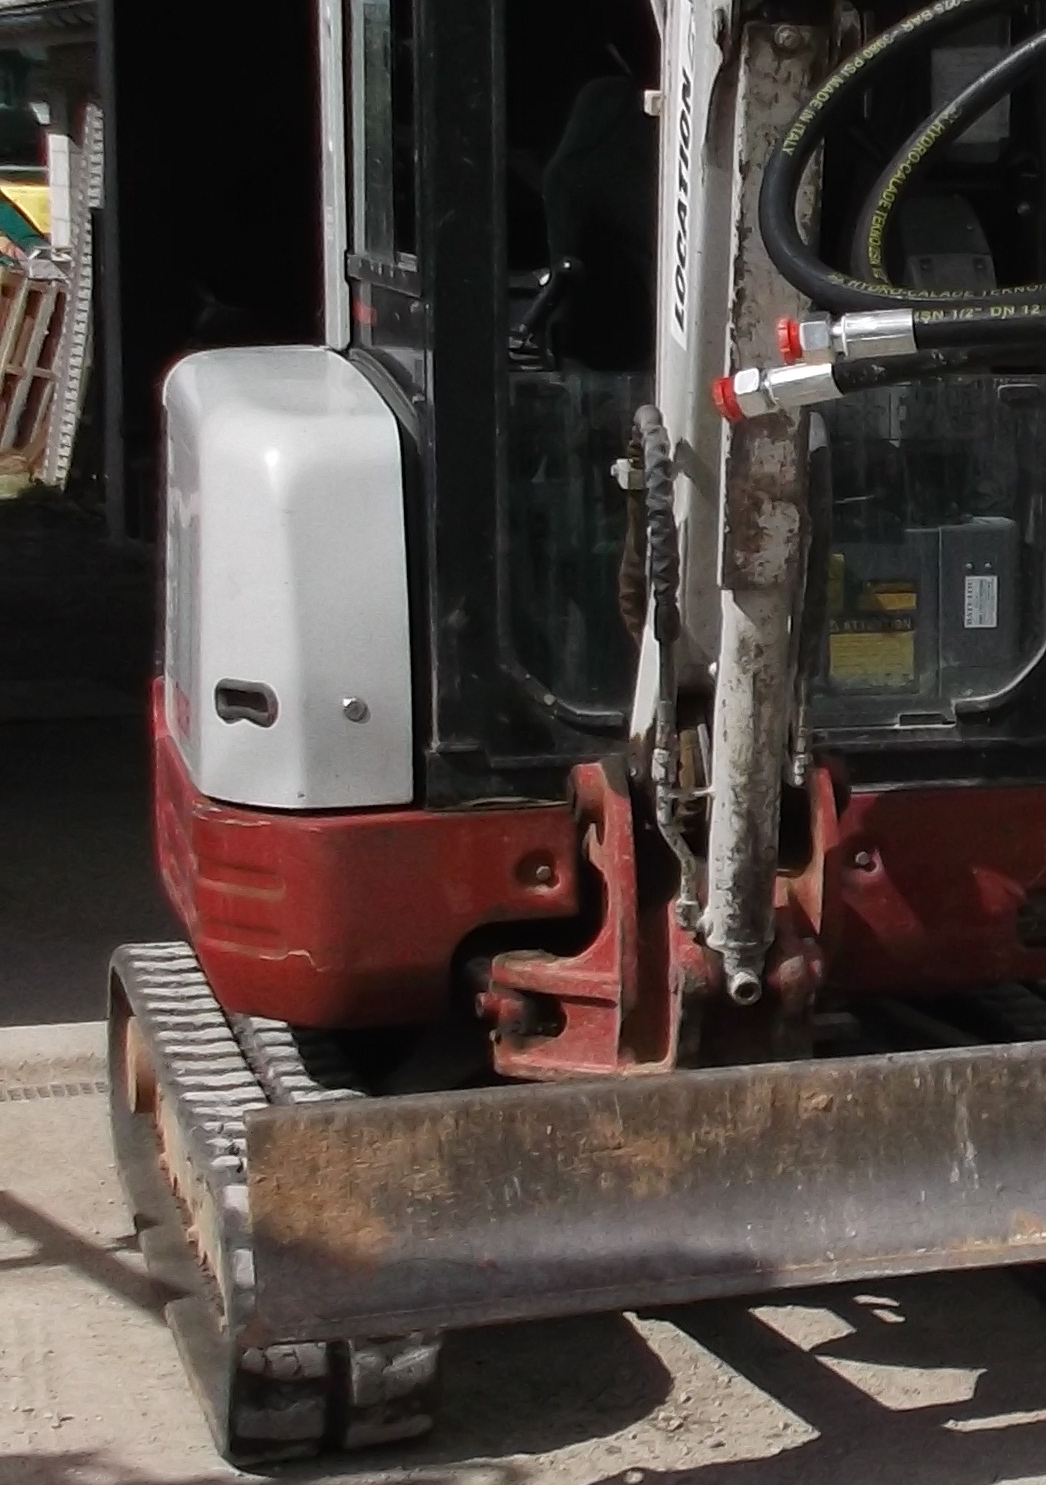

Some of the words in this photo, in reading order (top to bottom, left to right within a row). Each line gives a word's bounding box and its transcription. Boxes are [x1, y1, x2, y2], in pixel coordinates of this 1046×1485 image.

[808, 75, 844, 110] MADE
[782, 121, 807, 157] ITALY
[879, 122, 946, 210] HYDRO-CALADE
[673, 66, 693, 334] LOCATION
[990, 305, 1015, 318] DN
[1022, 304, 1040, 315] 12
